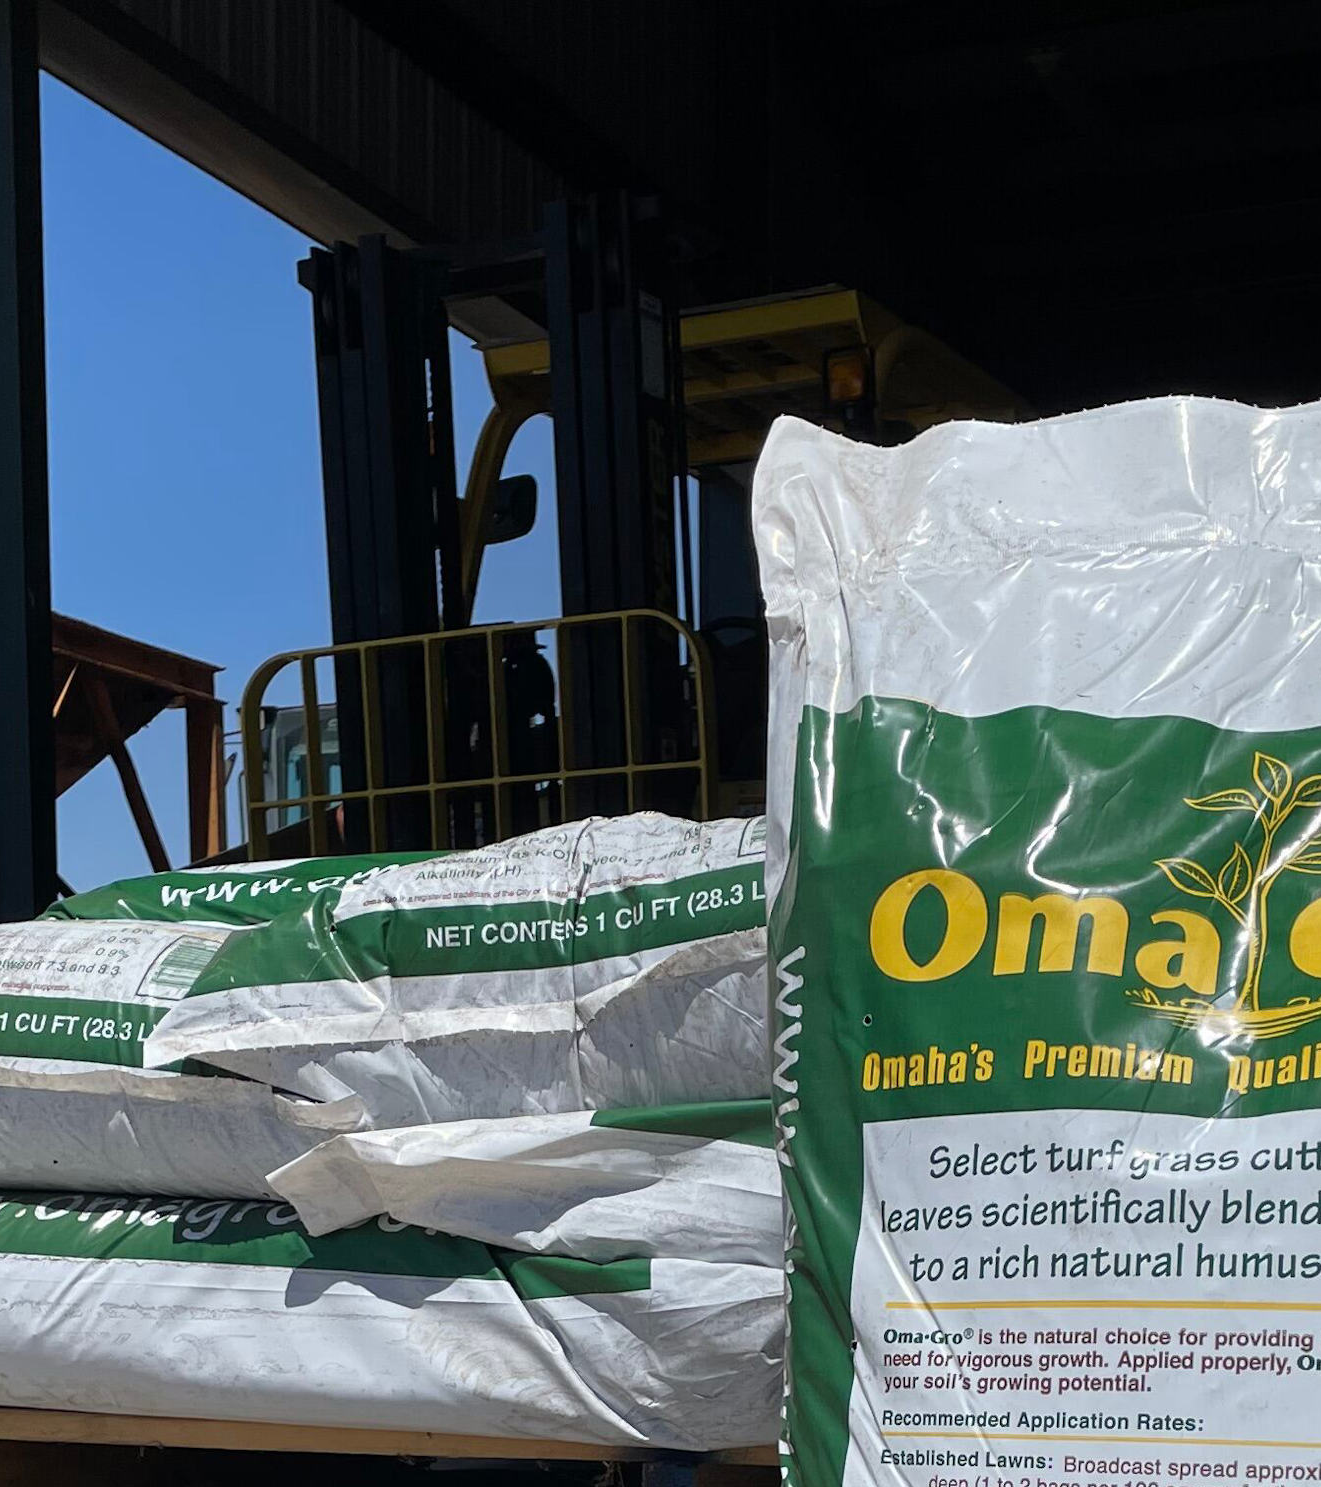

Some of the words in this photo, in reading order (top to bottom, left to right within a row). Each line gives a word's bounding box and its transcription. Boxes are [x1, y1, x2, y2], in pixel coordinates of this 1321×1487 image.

[415, 867, 486, 880] Alkalinity
[427, 925, 474, 948] NET
[596, 912, 605, 932] 1
[615, 904, 644, 929] CU
[652, 896, 681, 917] FT
[687, 884, 743, 917] (28.3
[869, 868, 1221, 995] Oma
[0, 1012, 8, 1031] 1
[15, 1013, 47, 1034] CU
[51, 1016, 80, 1036] FT
[83, 1017, 132, 1041] (28.3
[137, 1023, 158, 1042] L
[861, 1043, 995, 1092] Omaha's
[1024, 1039, 1194, 1085] Premium
[930, 1143, 1038, 1179] Select
[881, 1200, 972, 1233] leaves
[981, 1189, 1211, 1233] scientifically
[910, 1253, 944, 1282] to
[952, 1254, 969, 1281] a
[979, 1244, 1039, 1280] rich
[1050, 1242, 1183, 1278] natural
[978, 1329, 993, 1345] is
[999, 1329, 1027, 1345] the
[1034, 1328, 1098, 1345] natural
[1105, 1328, 1171, 1346] choice
[1178, 1328, 1207, 1345] for
[1215, 1329, 1314, 1351] providing
[883, 1350, 921, 1367] need
[927, 1350, 952, 1367] for
[957, 1351, 1032, 1372] vigorous
[1038, 1351, 1109, 1372] growth.
[1117, 1351, 1194, 1372] Applied
[1200, 1353, 1292, 1375] properly,
[884, 1374, 918, 1392] your
[924, 1373, 971, 1390] soil's
[977, 1376, 1052, 1394] growing
[1058, 1374, 1152, 1395] potential.
[882, 1410, 1010, 1428] Recommended
[1017, 1412, 1129, 1432] Application
[1137, 1413, 1204, 1432] Rates:
[881, 1449, 978, 1467] Established
[985, 1452, 1053, 1470] Lawns:
[1064, 1455, 1161, 1476] Broadcast
[1168, 1459, 1238, 1481] spread
